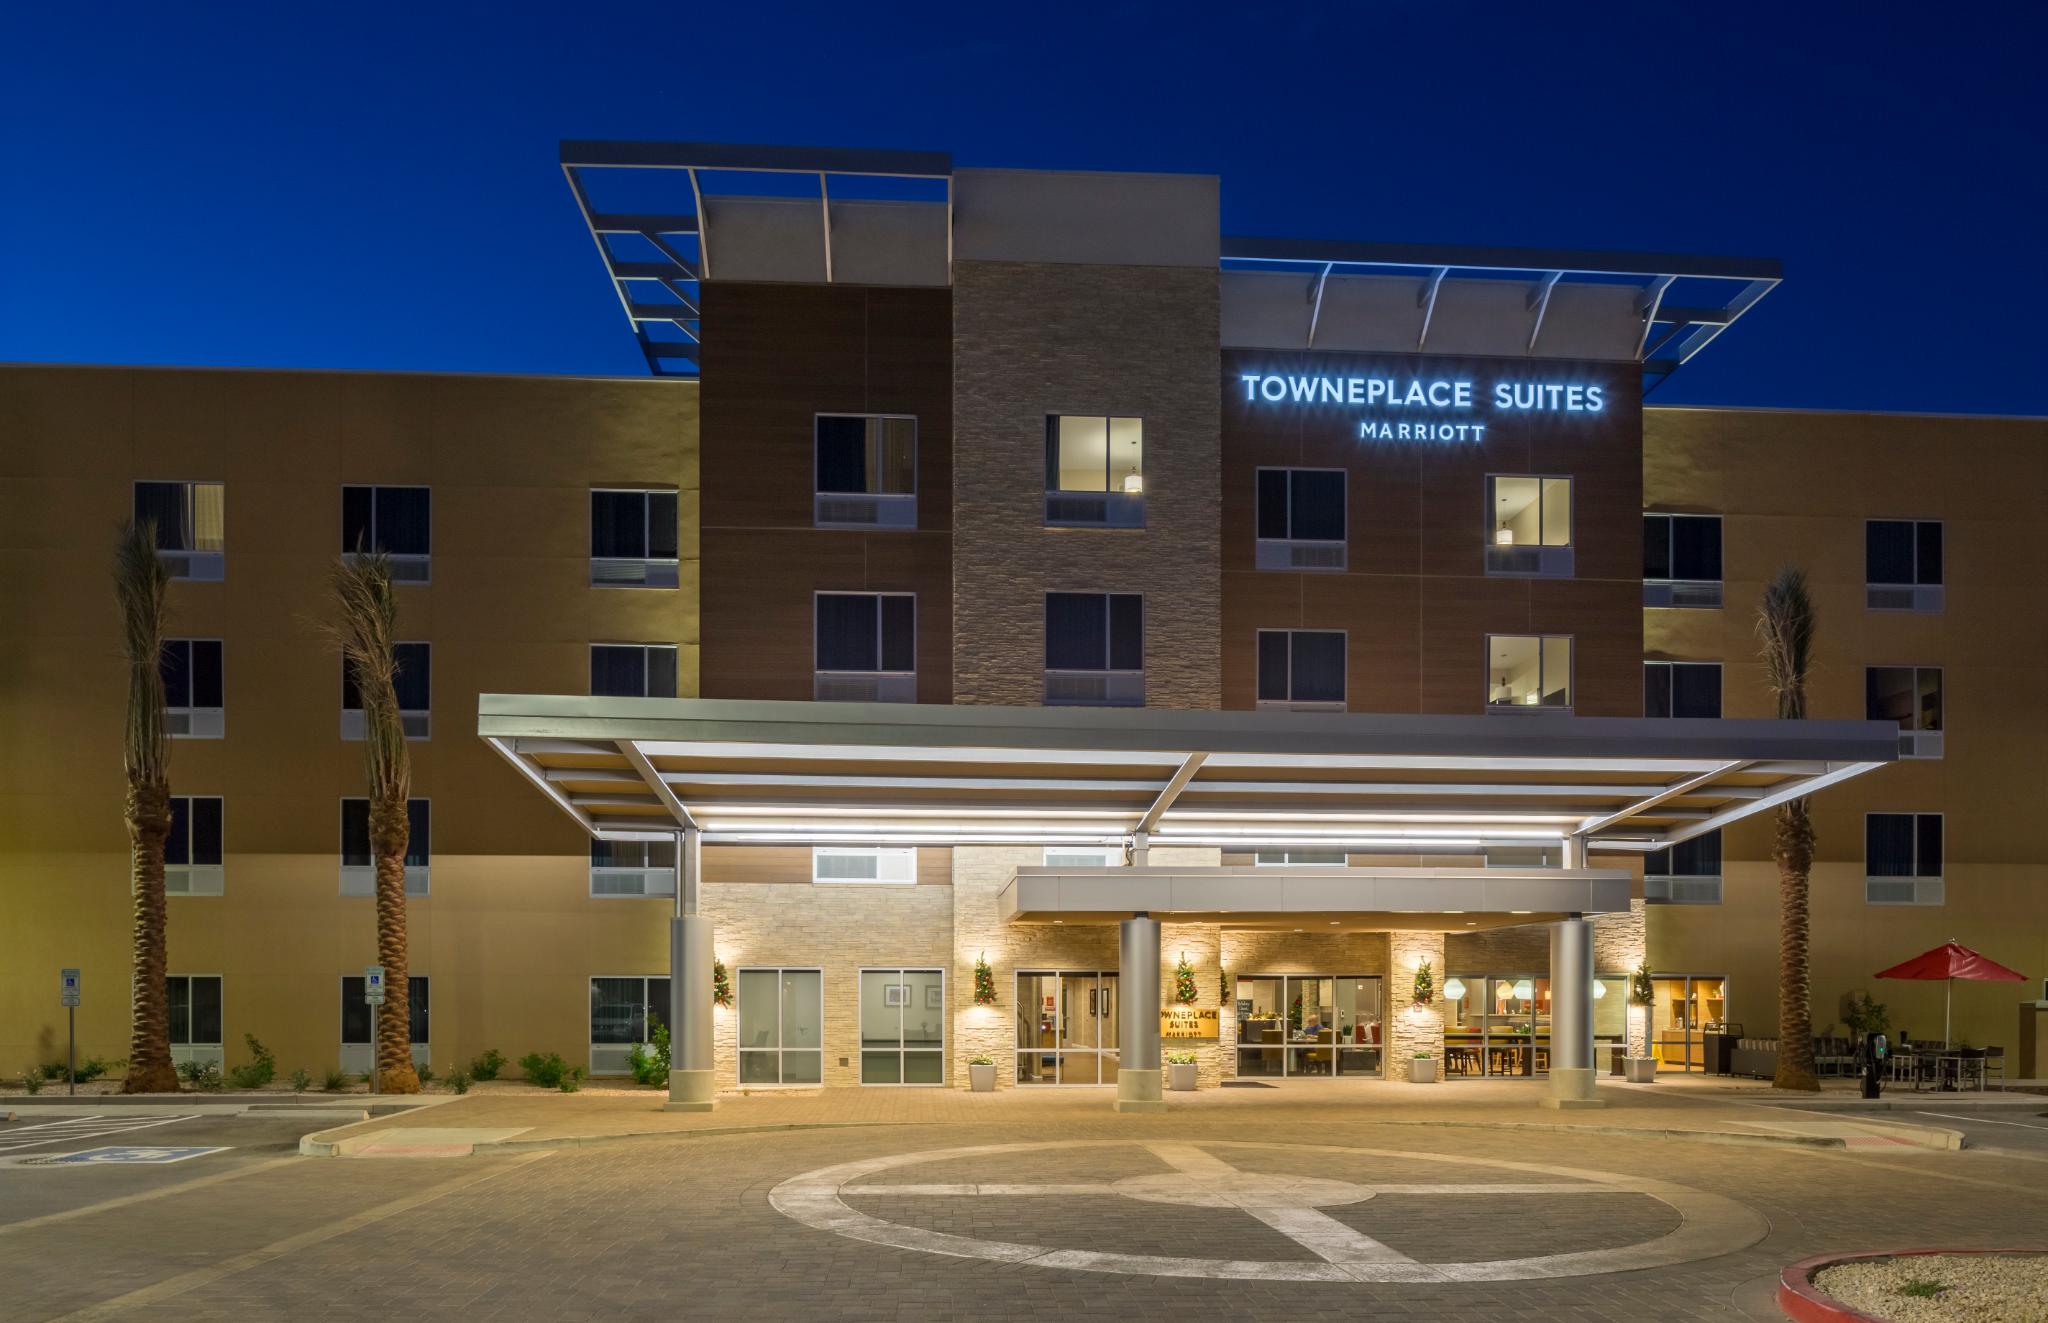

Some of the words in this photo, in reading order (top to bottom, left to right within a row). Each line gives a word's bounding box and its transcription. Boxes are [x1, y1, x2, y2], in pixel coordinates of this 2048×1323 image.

[1242, 374, 1471, 407] TOWNEPLACE
[1495, 383, 1604, 411] SUITES
[1360, 421, 1485, 441] MARRIOTT
